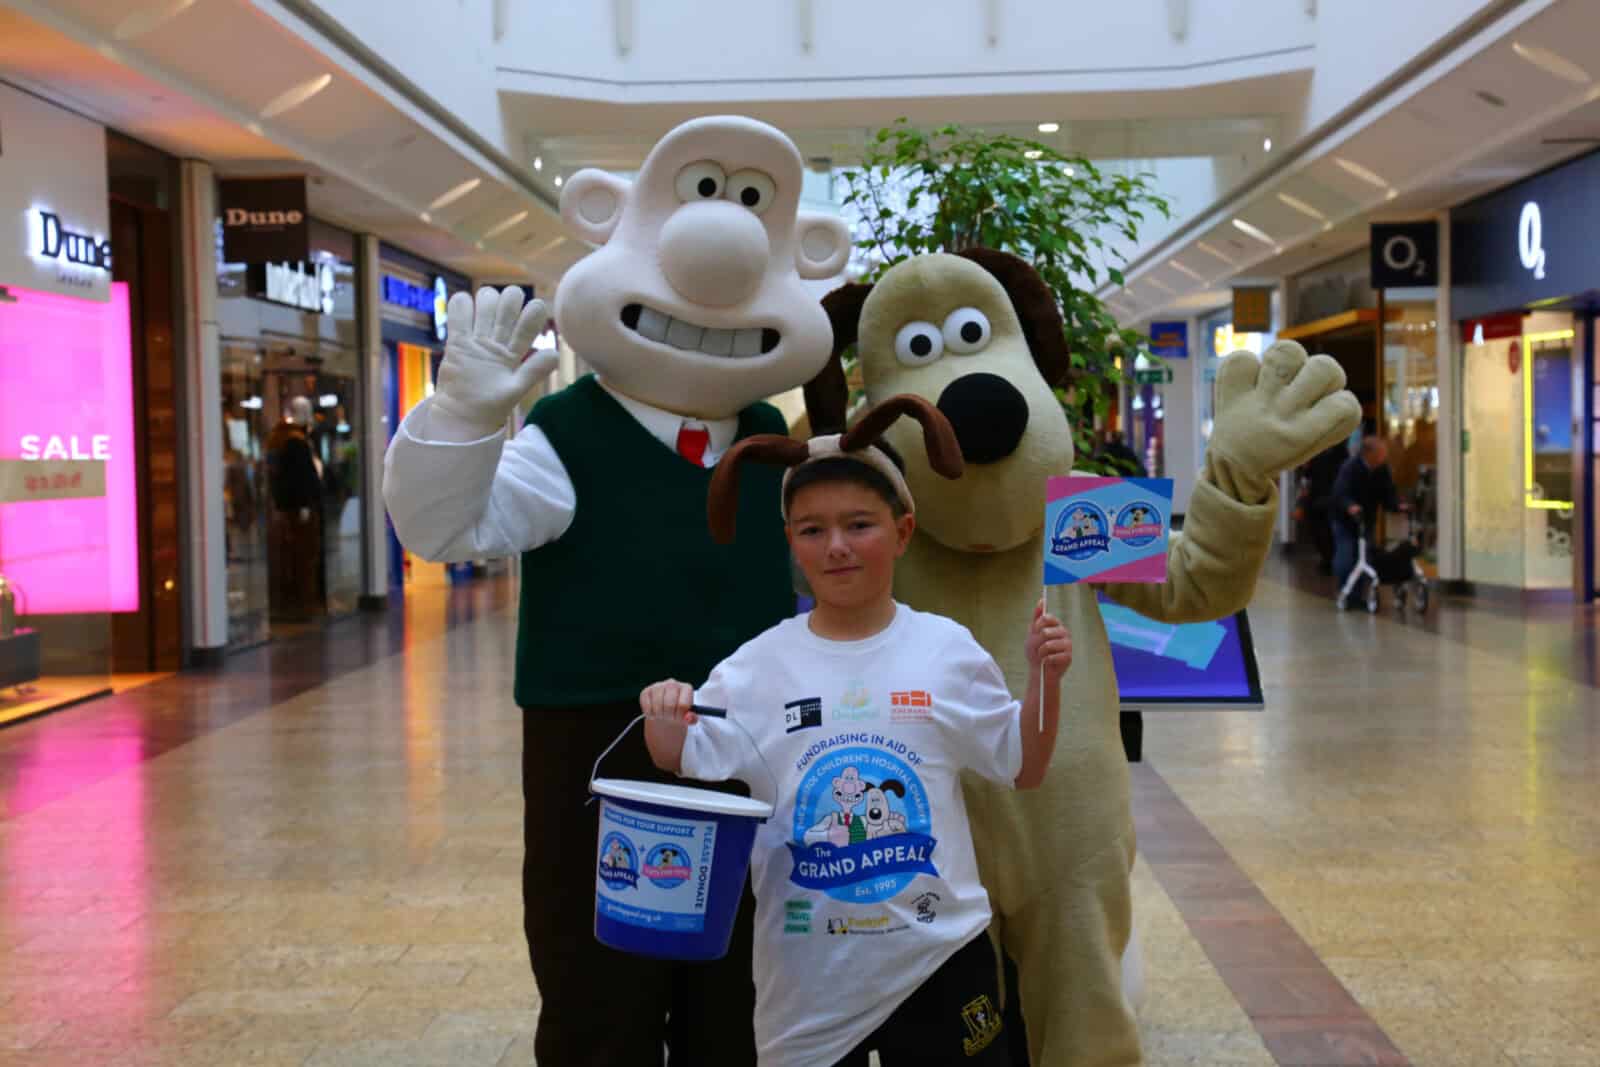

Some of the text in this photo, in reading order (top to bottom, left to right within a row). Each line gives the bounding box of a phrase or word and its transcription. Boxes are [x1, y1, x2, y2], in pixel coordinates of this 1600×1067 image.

[225, 207, 304, 226] Dune
[39, 210, 112, 272] Dune
[20, 434, 112, 461] SALE
[796, 732, 923, 771] FUNDRAISING IN AID OF
[816, 753, 870, 777] CHILDREN'S
[870, 755, 914, 785] HOSPITAL
[656, 823, 690, 835] SUPPORT
[694, 825, 714, 909] PLEASE DONATE
[799, 845, 927, 879] GRAND APPEAL
[815, 847, 832, 858] The
[855, 887, 873, 897] Est.
